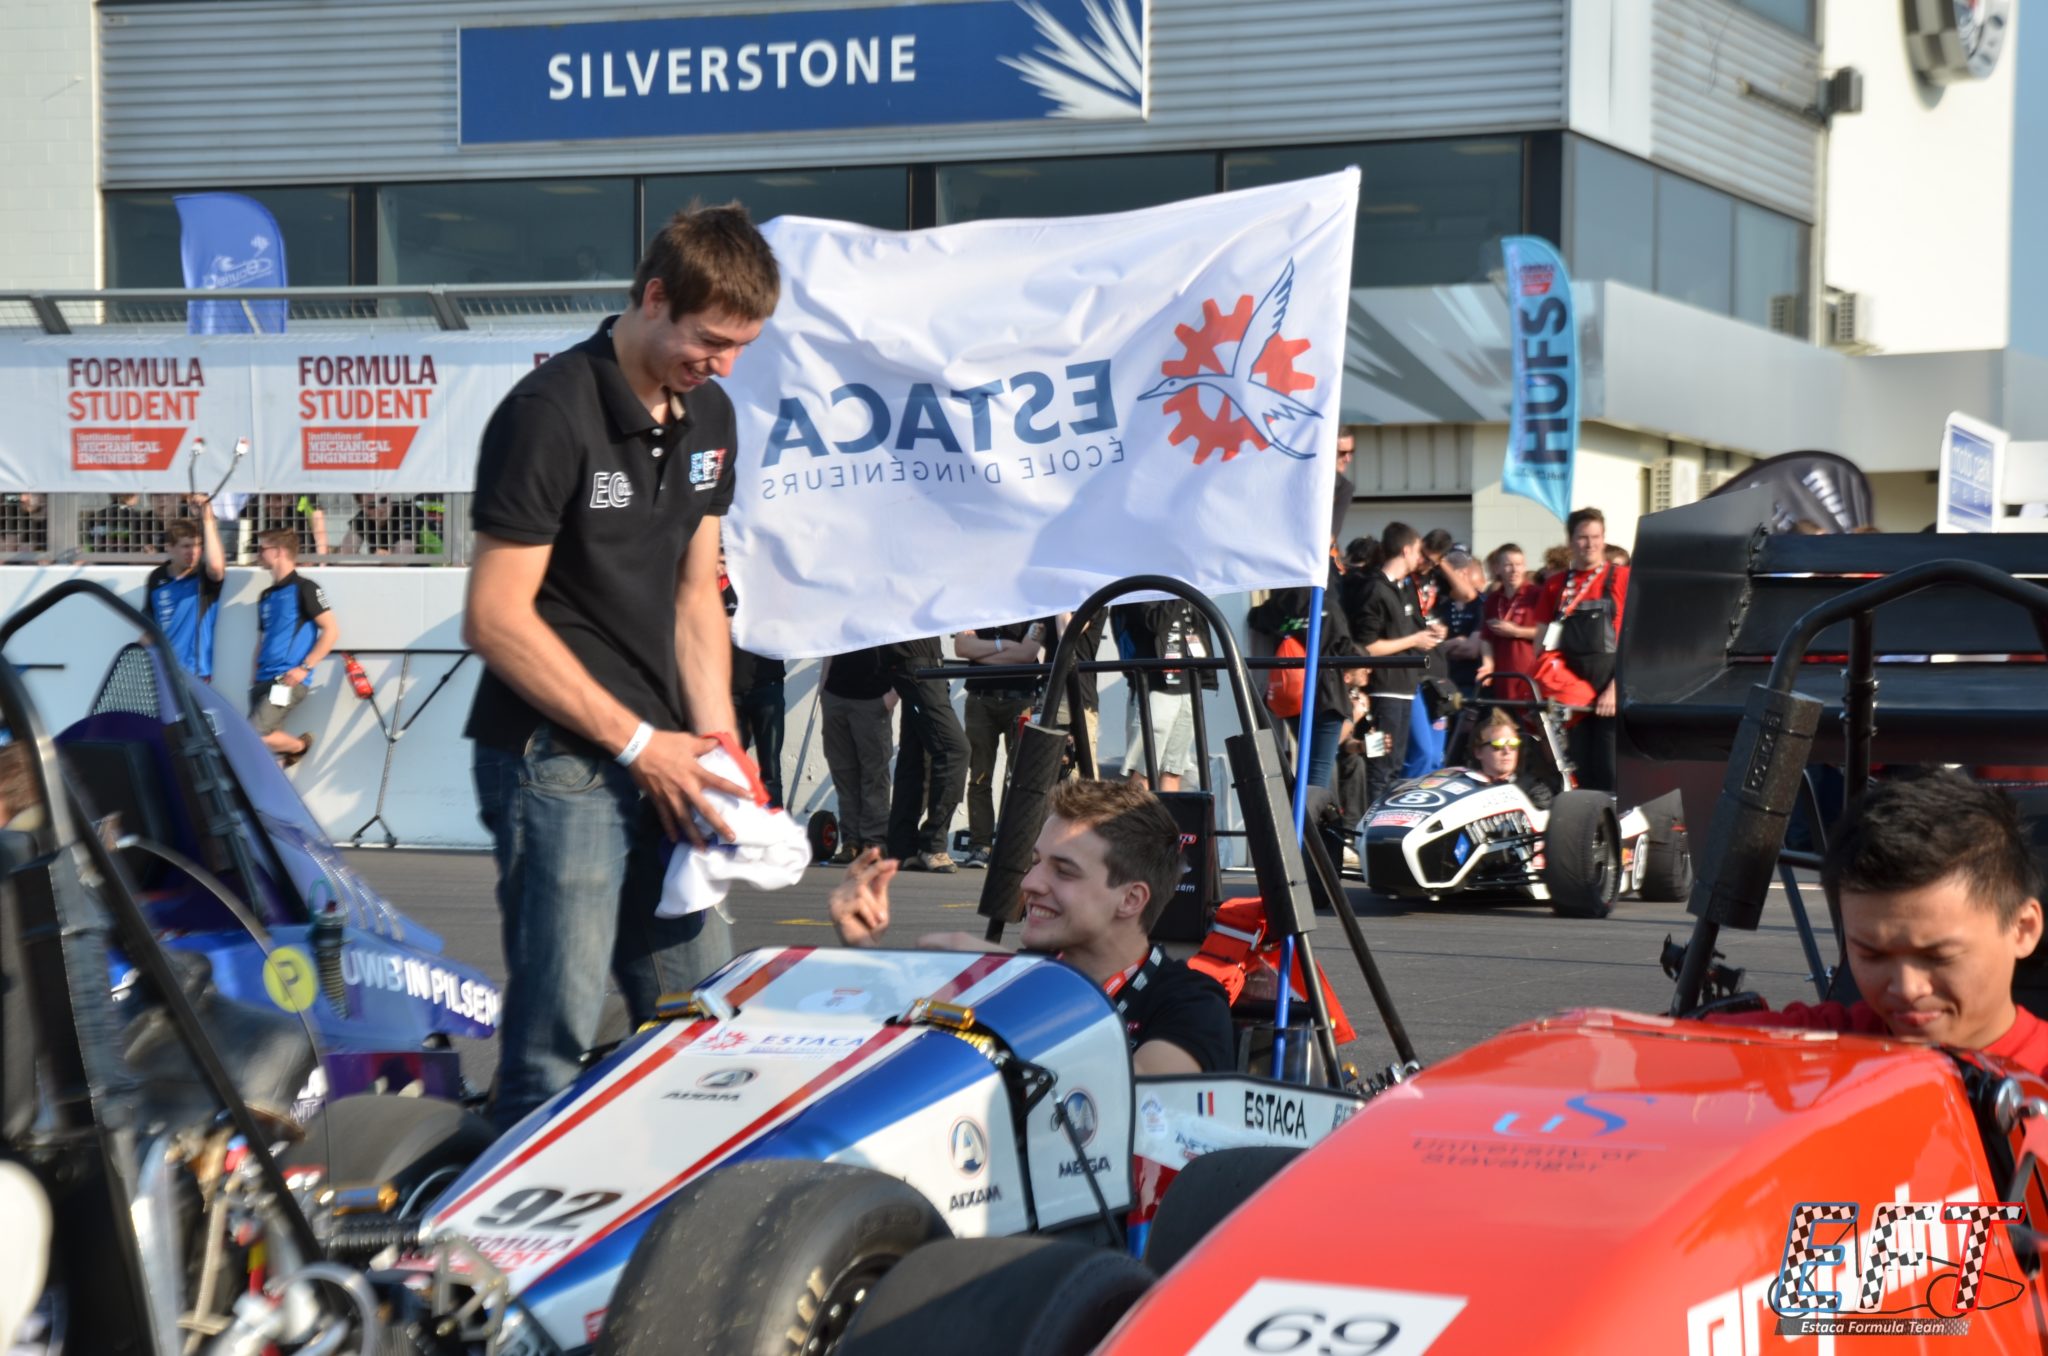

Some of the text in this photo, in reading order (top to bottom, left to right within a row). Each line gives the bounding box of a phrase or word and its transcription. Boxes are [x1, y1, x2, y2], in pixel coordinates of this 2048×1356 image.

[547, 34, 917, 101] SILVERSTONE
[68, 357, 205, 388] FORMULA
[298, 354, 437, 387] FORMULA
[1520, 296, 1568, 465] HUFS
[68, 390, 200, 421] STUDENT
[298, 388, 432, 420] STUDENT
[308, 440, 391, 452] MECHANICAL
[308, 452, 378, 464] ENGINEERS
[341, 950, 502, 1027] UWB IN PILSEN
[759, 1034, 865, 1048] ESTACA
[662, 1091, 741, 1102] AIXAM
[1244, 1091, 1307, 1139] ESTACA
[1058, 1156, 1111, 1179] MEGA
[474, 1187, 623, 1231] 92
[949, 1184, 1002, 1212] AIXAM
[1244, 1305, 1401, 1356] 69
